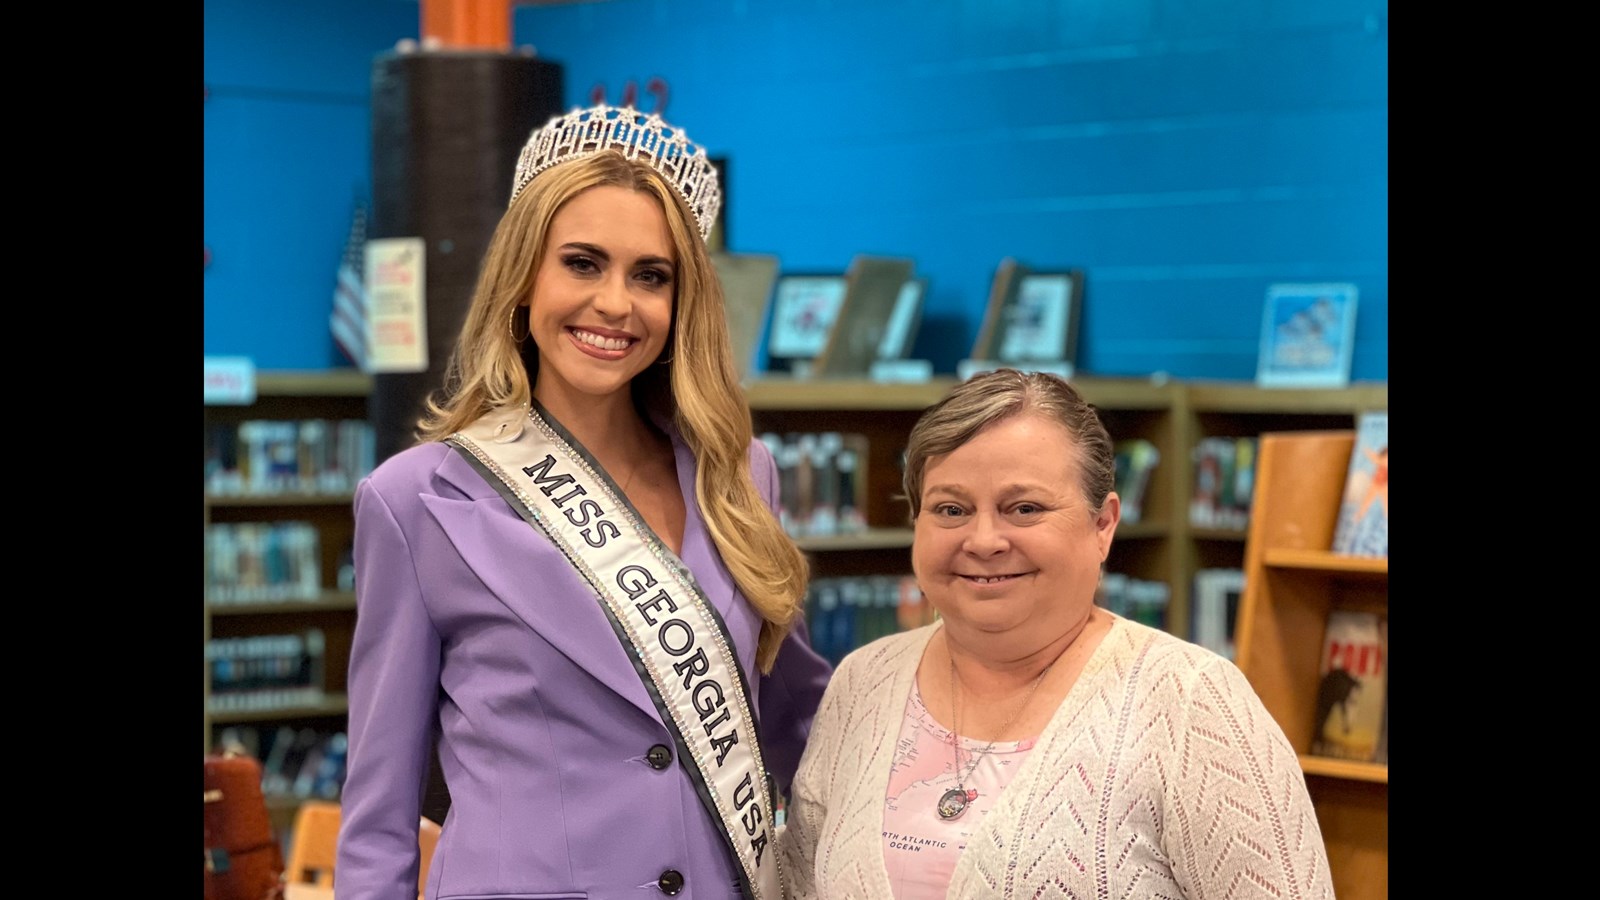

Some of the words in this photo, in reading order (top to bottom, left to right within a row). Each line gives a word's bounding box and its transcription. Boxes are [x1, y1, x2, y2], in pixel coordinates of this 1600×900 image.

[522, 454, 621, 548] MISS
[616, 565, 739, 768] GEORGIA
[733, 772, 767, 868] USA
[889, 841, 922, 852] OCEAN
[902, 835, 947, 849] ATLANTIC
